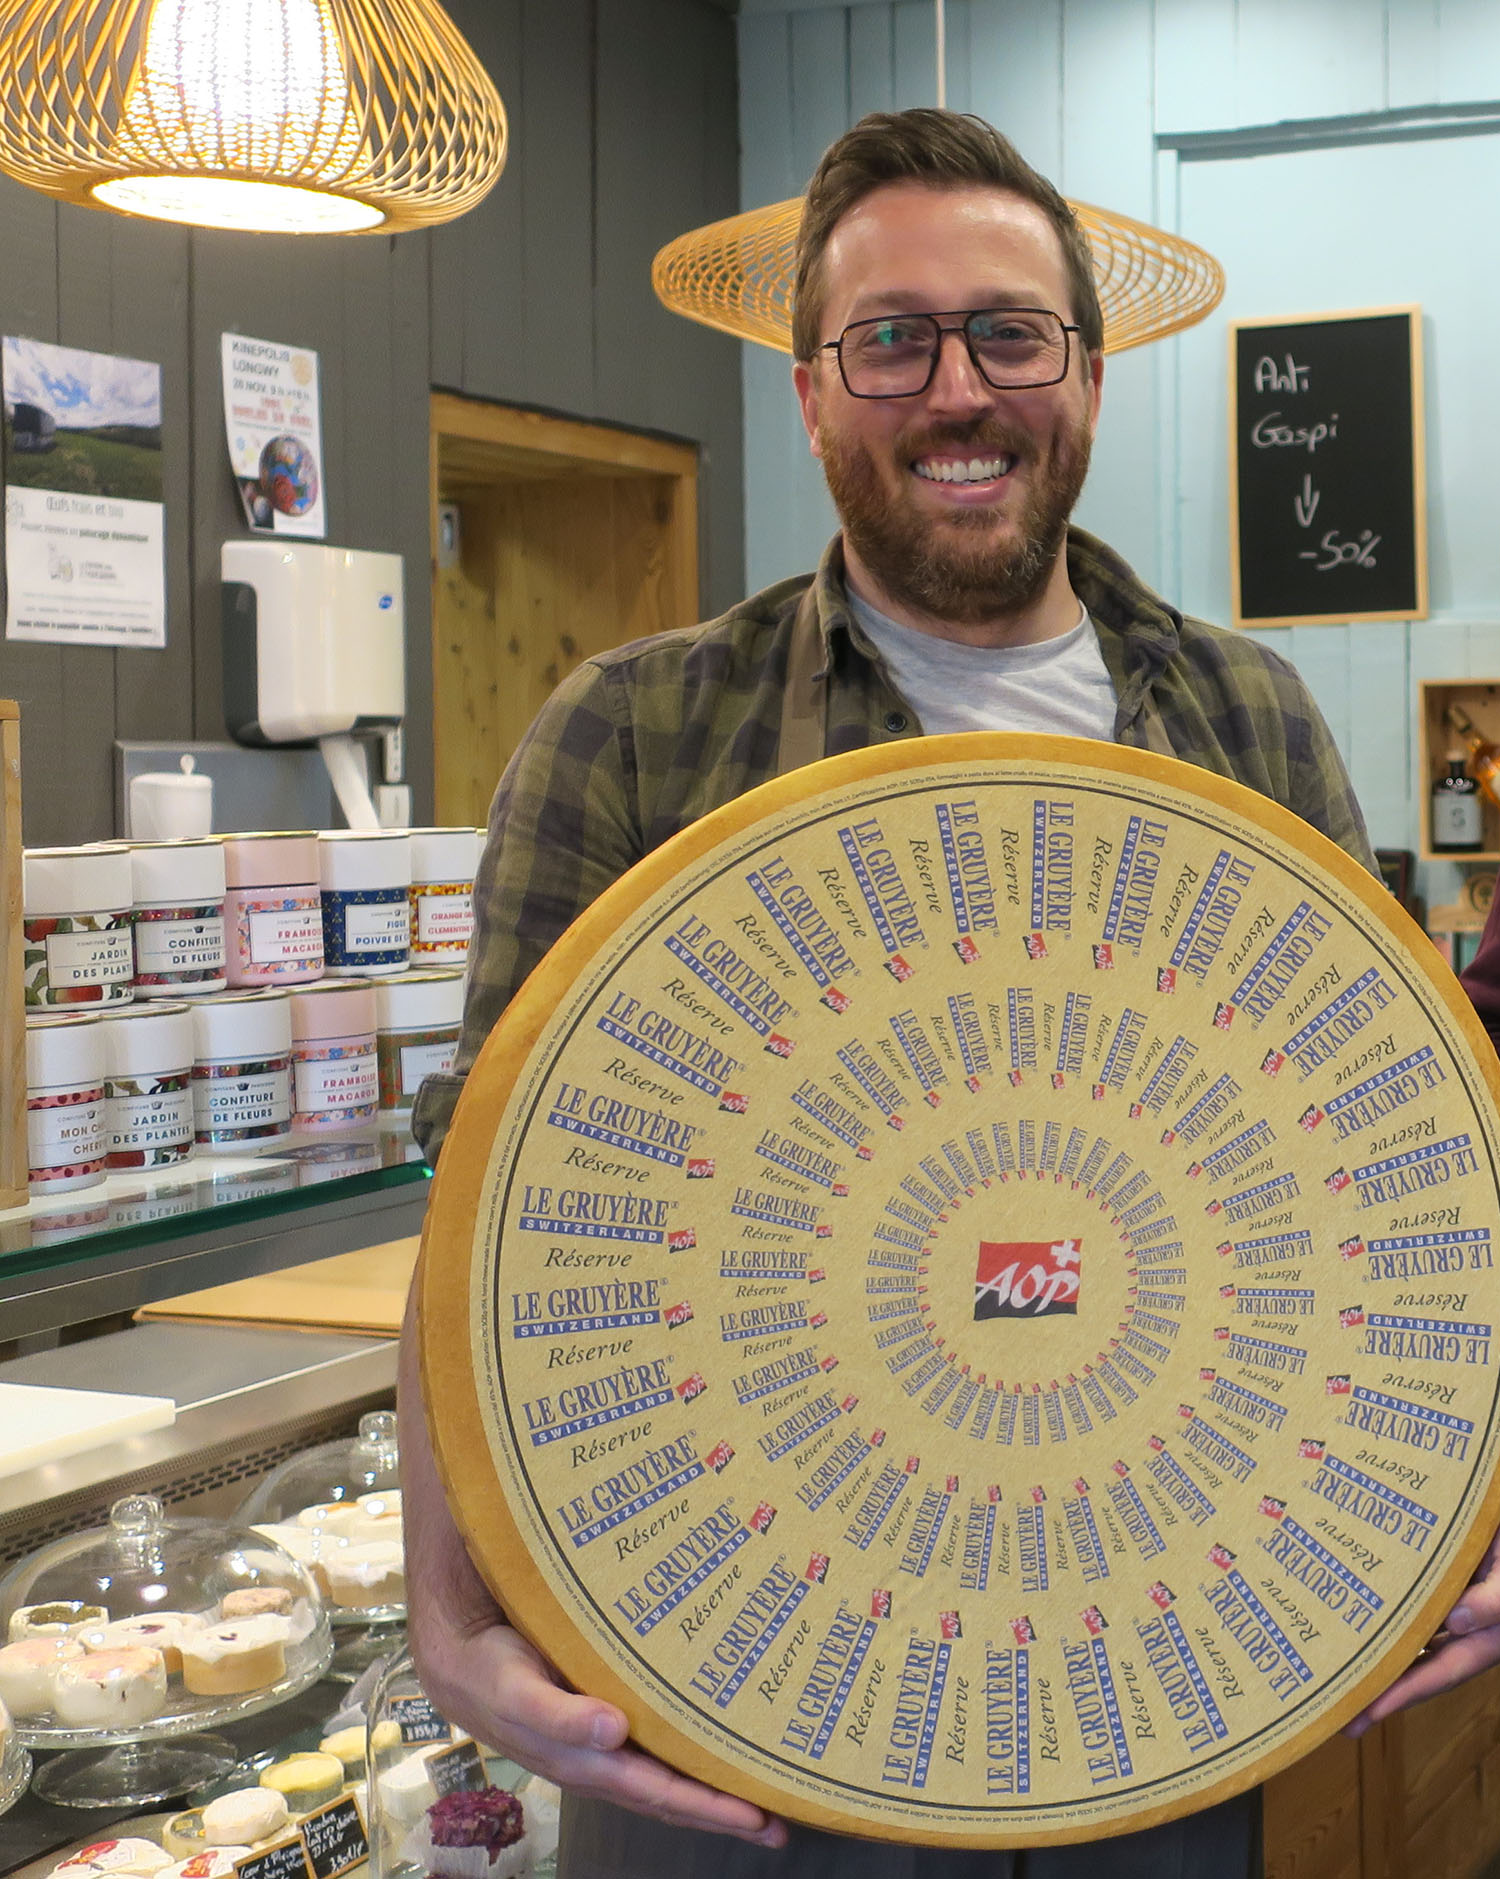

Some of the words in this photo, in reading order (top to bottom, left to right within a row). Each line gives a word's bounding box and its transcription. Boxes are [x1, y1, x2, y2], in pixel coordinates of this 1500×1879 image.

[1255, 353, 1311, 393] Anti
[1252, 412, 1339, 452] Gaspi
[1299, 529, 1382, 570] -50%
[1049, 800, 1073, 826] LE
[851, 816, 884, 849] LE
[1001, 828, 1021, 904] Réserve
[1032, 806, 1043, 923] SWITZERLAND
[817, 865, 867, 939] Réserve
[840, 833, 895, 948] SWITZERLAND
[355, 935, 393, 945] POIVRE
[674, 913, 712, 949] LE
[91, 949, 128, 961] JARDIN
[172, 954, 188, 965] DE
[72, 968, 97, 979] DES
[669, 940, 765, 1032] SWITZERLAND
[604, 990, 642, 1026] LE
[661, 974, 736, 1037] Réserve
[602, 1020, 715, 1093] SWITZERLAND
[323, 1073, 375, 1088] FRAMBOISE
[327, 1090, 375, 1103] MACARON
[603, 1054, 687, 1105] Réserve
[209, 1092, 274, 1107] CONFITURE
[213, 1113, 228, 1122] DE
[234, 1108, 272, 1121] FLEURS
[552, 1082, 587, 1115] LE
[61, 1128, 88, 1139] MON
[113, 1134, 138, 1145] DES
[146, 1127, 190, 1141] PLANTES
[132, 1112, 179, 1126] JARDIN
[553, 1115, 678, 1164] SWITZERLAND
[758, 1128, 780, 1150] LE
[564, 1145, 652, 1182] Réserve
[758, 1167, 809, 1193] Réserve
[521, 1185, 553, 1214] LE
[526, 1219, 657, 1241] SWITZERLAND
[545, 1245, 634, 1267] Réserve
[720, 1250, 738, 1267] LE
[735, 1285, 786, 1298] Réserve
[975, 1262, 1080, 1314] AOP
[511, 1291, 542, 1322] LE
[520, 1311, 654, 1336] SWITZERLAND
[548, 1337, 634, 1369] Réserve
[730, 1373, 753, 1396] LE
[762, 1384, 809, 1418] Réserve
[521, 1395, 557, 1431] LE
[537, 1391, 668, 1443] SWITZERLAND
[570, 1419, 655, 1469] Réserve
[555, 1495, 594, 1533] LE
[578, 1465, 700, 1543] SWITZERLAND
[613, 1496, 693, 1561] Réserve
[640, 1531, 746, 1631] SWITZERLAND
[612, 1585, 652, 1625] LE
[676, 1562, 747, 1640] Réserve
[813, 1626, 874, 1752] SWITZERLAND
[844, 1655, 888, 1747] Réserve
[780, 1718, 815, 1753] LE
[1017, 1654, 1028, 1786] SWITZERLAND
[1038, 1675, 1060, 1760] Réserve
[986, 1765, 1013, 1795] LE
